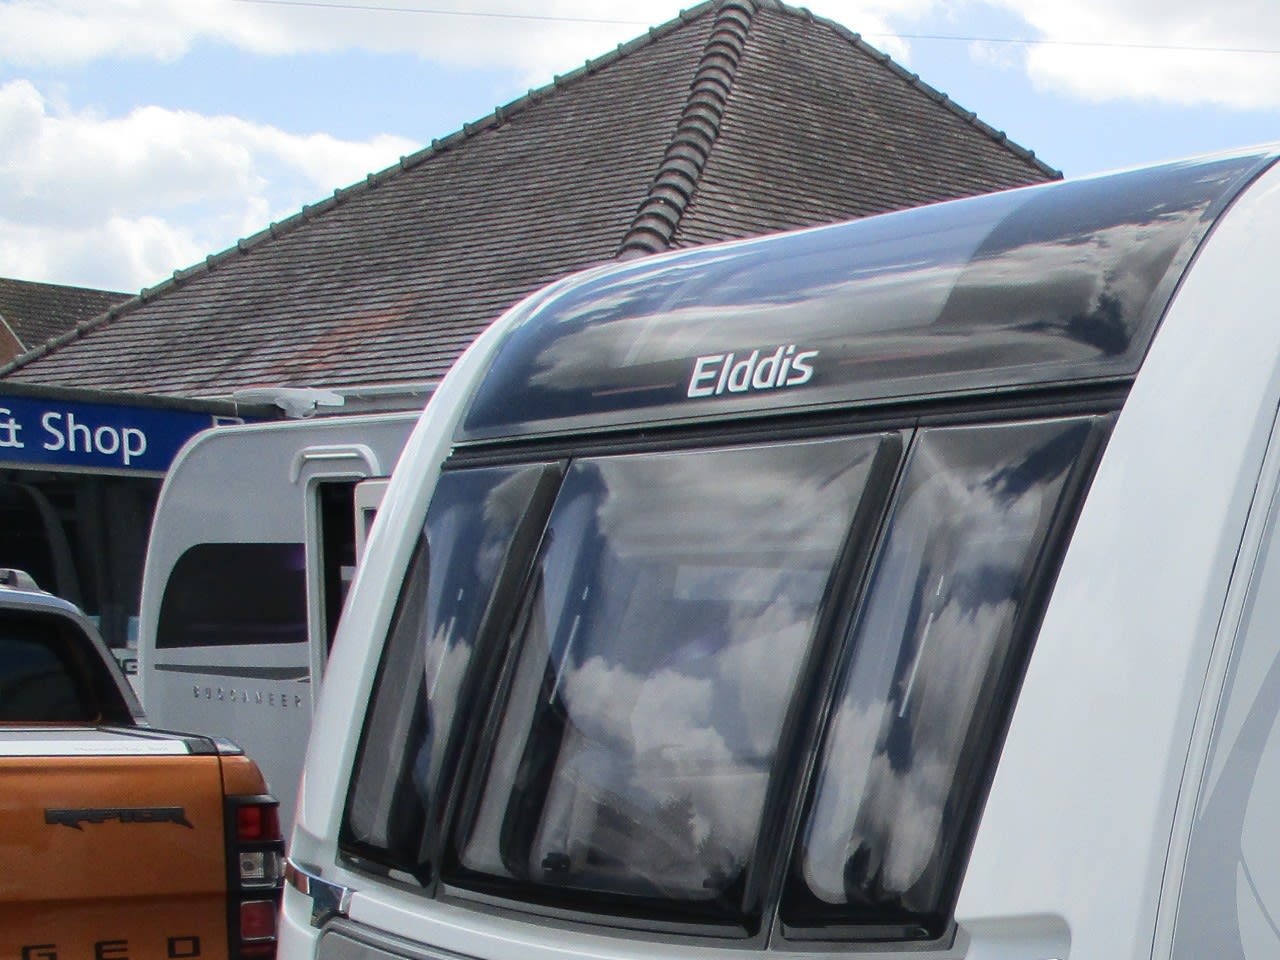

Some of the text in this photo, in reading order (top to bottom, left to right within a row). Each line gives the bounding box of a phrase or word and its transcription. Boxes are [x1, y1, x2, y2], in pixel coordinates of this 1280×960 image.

[687, 344, 820, 398] Elddis
[0, 407, 147, 466] & Shop
[192, 685, 302, 708] BUCCANEER
